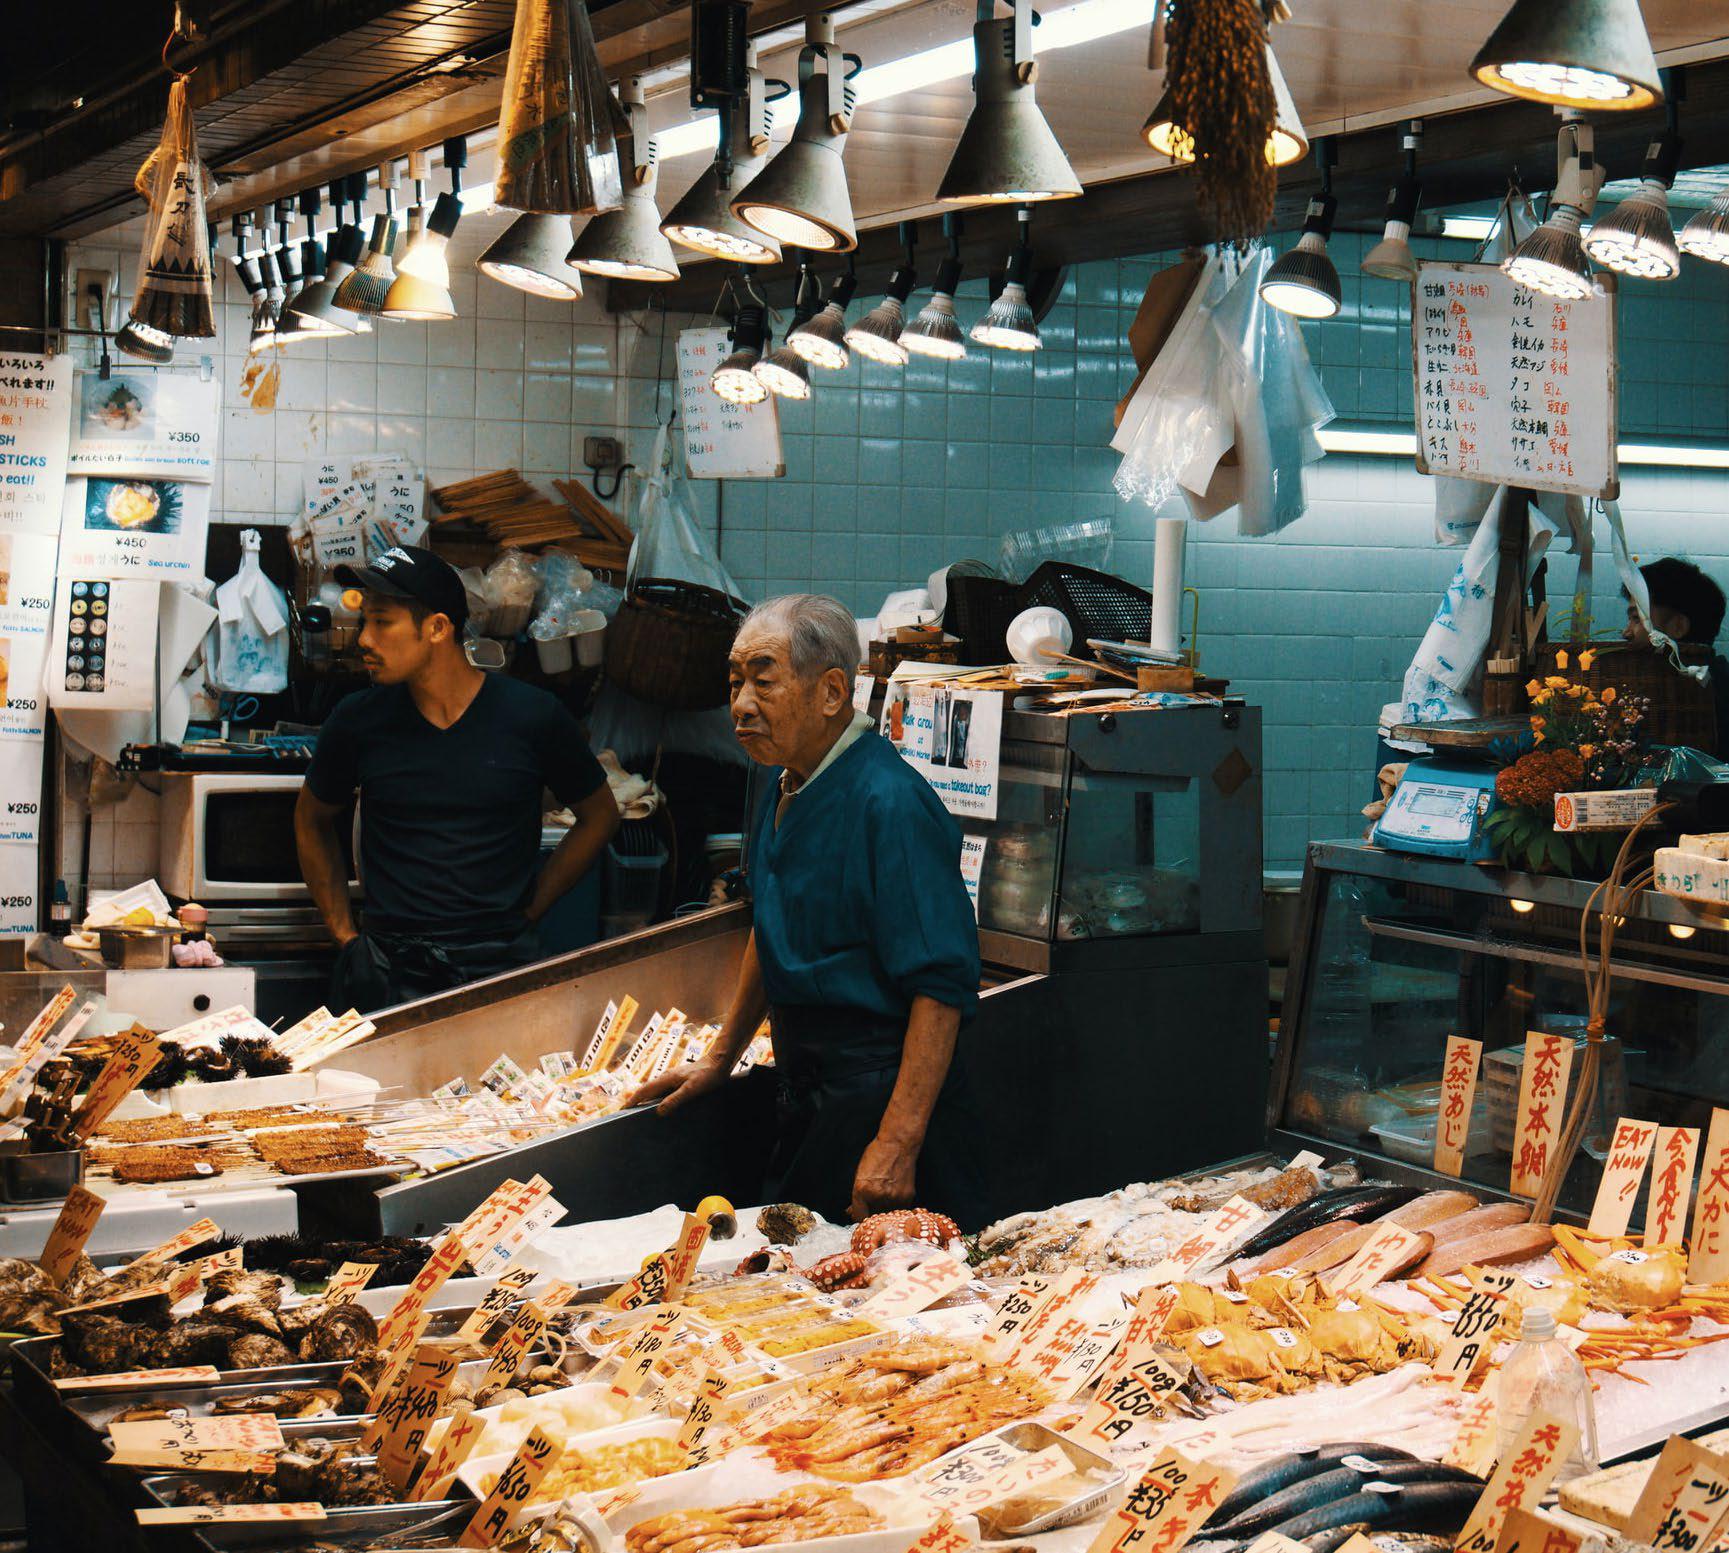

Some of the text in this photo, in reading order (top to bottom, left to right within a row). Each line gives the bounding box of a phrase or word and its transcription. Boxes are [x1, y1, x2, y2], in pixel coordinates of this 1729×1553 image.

[1511, 377, 1529, 391] タコ
[169, 432, 200, 442] ¥350
[0, 454, 46, 467] STICKS
[6, 474, 35, 485] eat!!
[390, 486, 410, 496] うに
[116, 537, 147, 547] ¥450
[120, 555, 141, 566] うに
[21, 598, 50, 610] ¥250
[6, 698, 37, 711] ¥250
[951, 779, 973, 793] takeout
[975, 783, 992, 796] bag?
[7, 802, 37, 815] ¥250
[1, 896, 32, 907] ¥250
[12, 924, 35, 933] TUNA
[113, 1039, 140, 1061] ¥250
[1445, 1044, 1472, 1148] 天然あじ
[1513, 1036, 1561, 1179] 天然本鯛
[1614, 1126, 1652, 1149] EAT
[1608, 1154, 1645, 1171] NOW
[1020, 1280, 1048, 1293] 一ツ
[996, 1293, 1032, 1315] ¥250
[513, 1309, 542, 1341] 100g
[657, 1310, 681, 1326] 一ツ
[998, 1320, 1019, 1334] 円
[629, 1331, 663, 1357] ¥180
[1064, 1338, 1102, 1364] ¥130
[1453, 1343, 1480, 1371] 円
[419, 1361, 454, 1378] 一ツ
[636, 1359, 653, 1376] 円
[1076, 1359, 1095, 1373] 円
[1132, 1359, 1176, 1393] 100g
[706, 1378, 727, 1392] 一ツ
[1105, 1376, 1156, 1417] ¥150
[685, 1396, 712, 1424] ¥130
[690, 1427, 706, 1443] 円
[1104, 1419, 1134, 1441] 円
[405, 1430, 424, 1454] 円
[526, 1437, 552, 1459] 一ツ
[929, 1459, 985, 1484] ¥300
[1691, 1479, 1729, 1504] 一ツ
[484, 1507, 508, 1538] 円
[1652, 1508, 1698, 1551] ¥300
